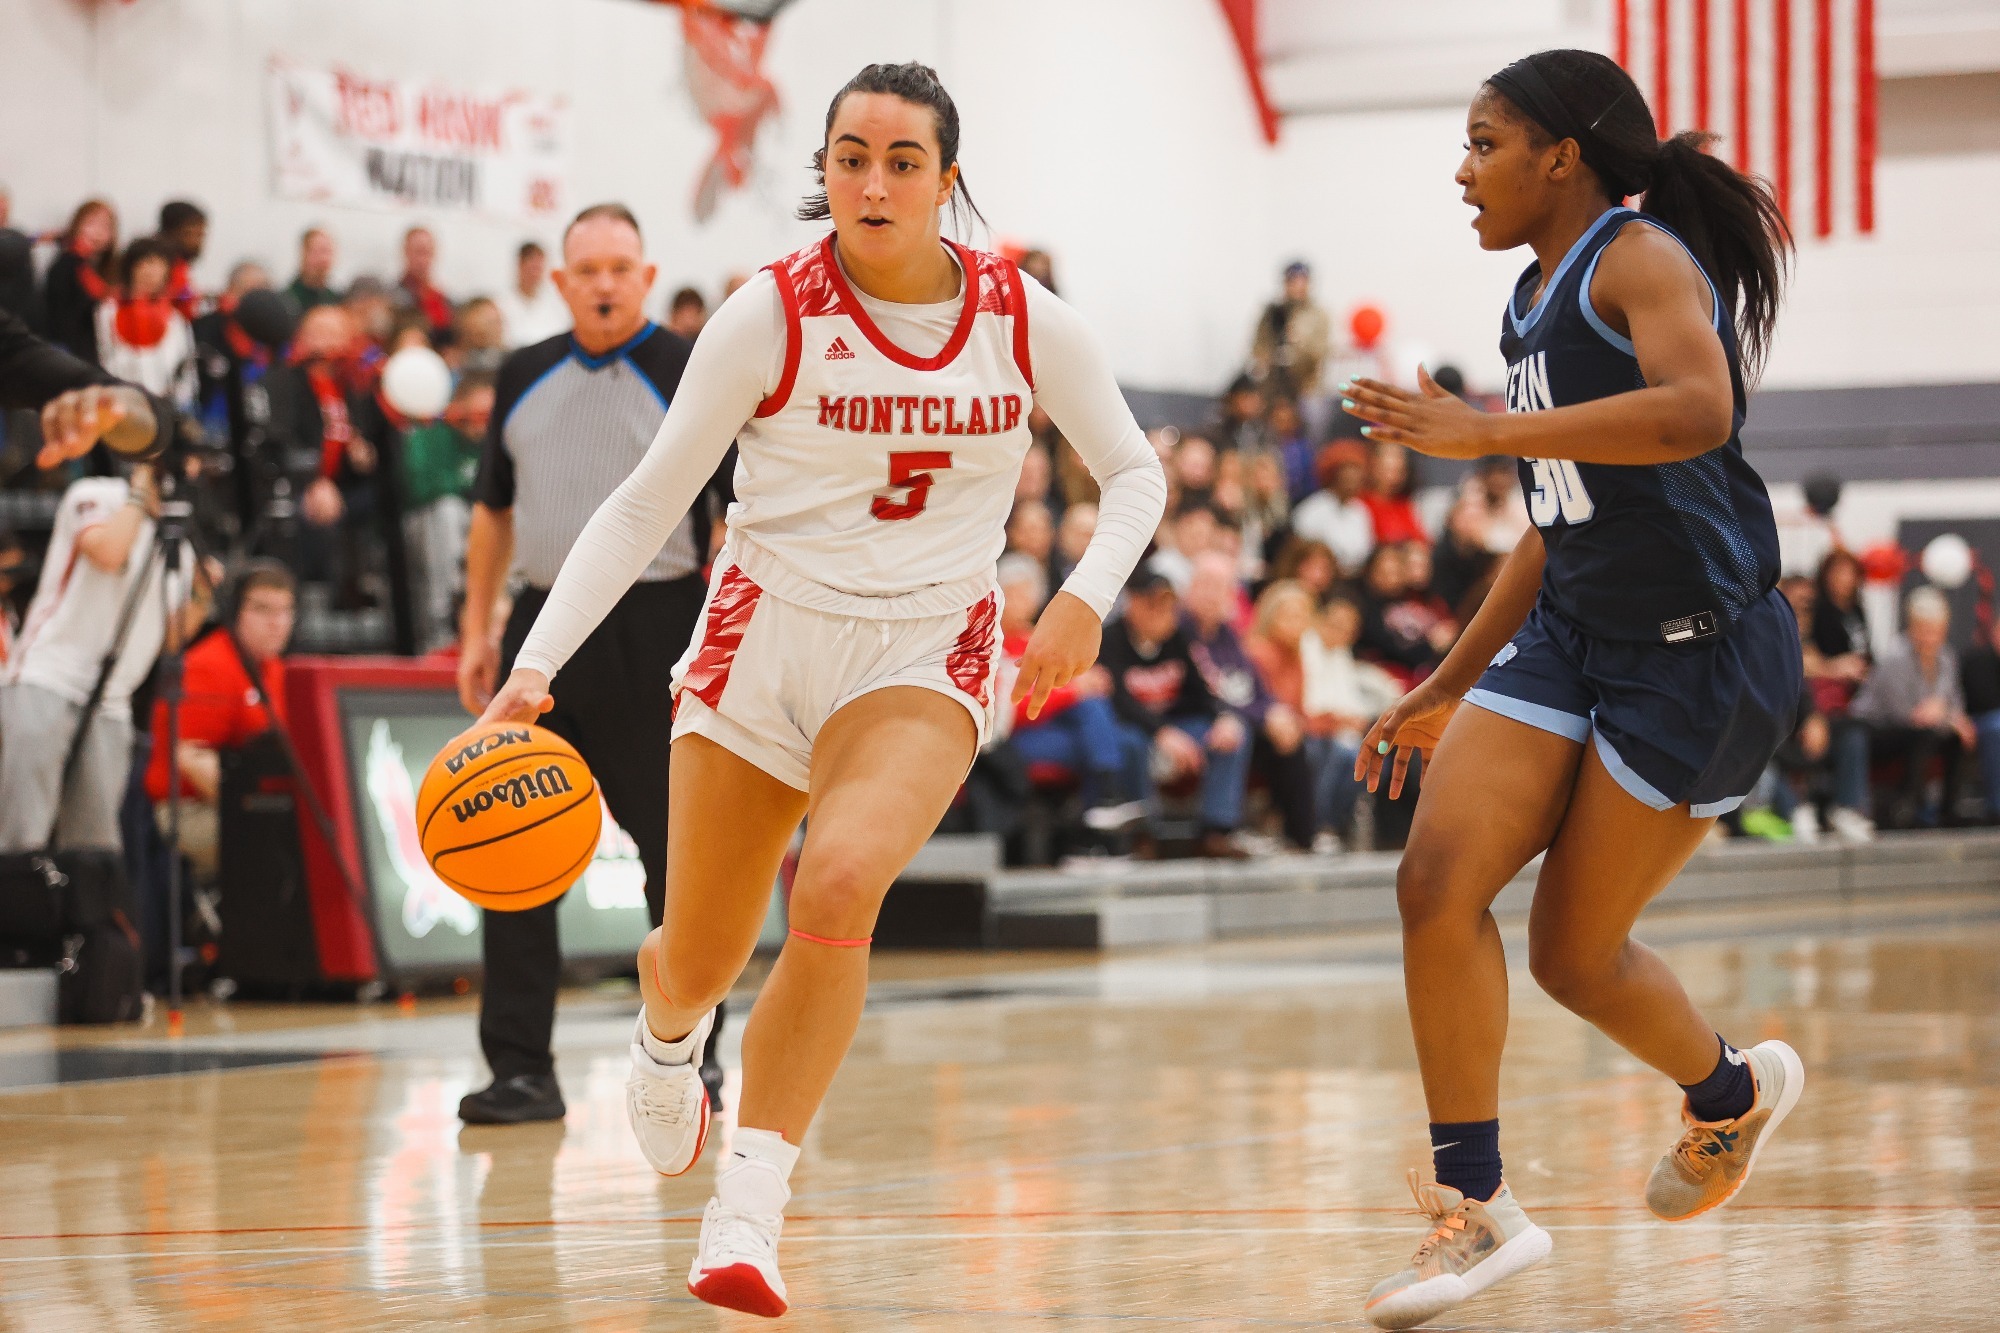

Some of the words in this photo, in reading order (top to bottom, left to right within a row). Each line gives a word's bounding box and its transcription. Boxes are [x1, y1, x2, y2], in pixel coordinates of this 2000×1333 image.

[824, 351, 855, 360] adidas
[816, 393, 1023, 436] MONTCLAIR
[868, 450, 953, 521] 5
[1522, 456, 1595, 527] 30
[1699, 620, 1708, 630] L
[445, 730, 532, 775] NCAA
[452, 764, 573, 823] Wilson
